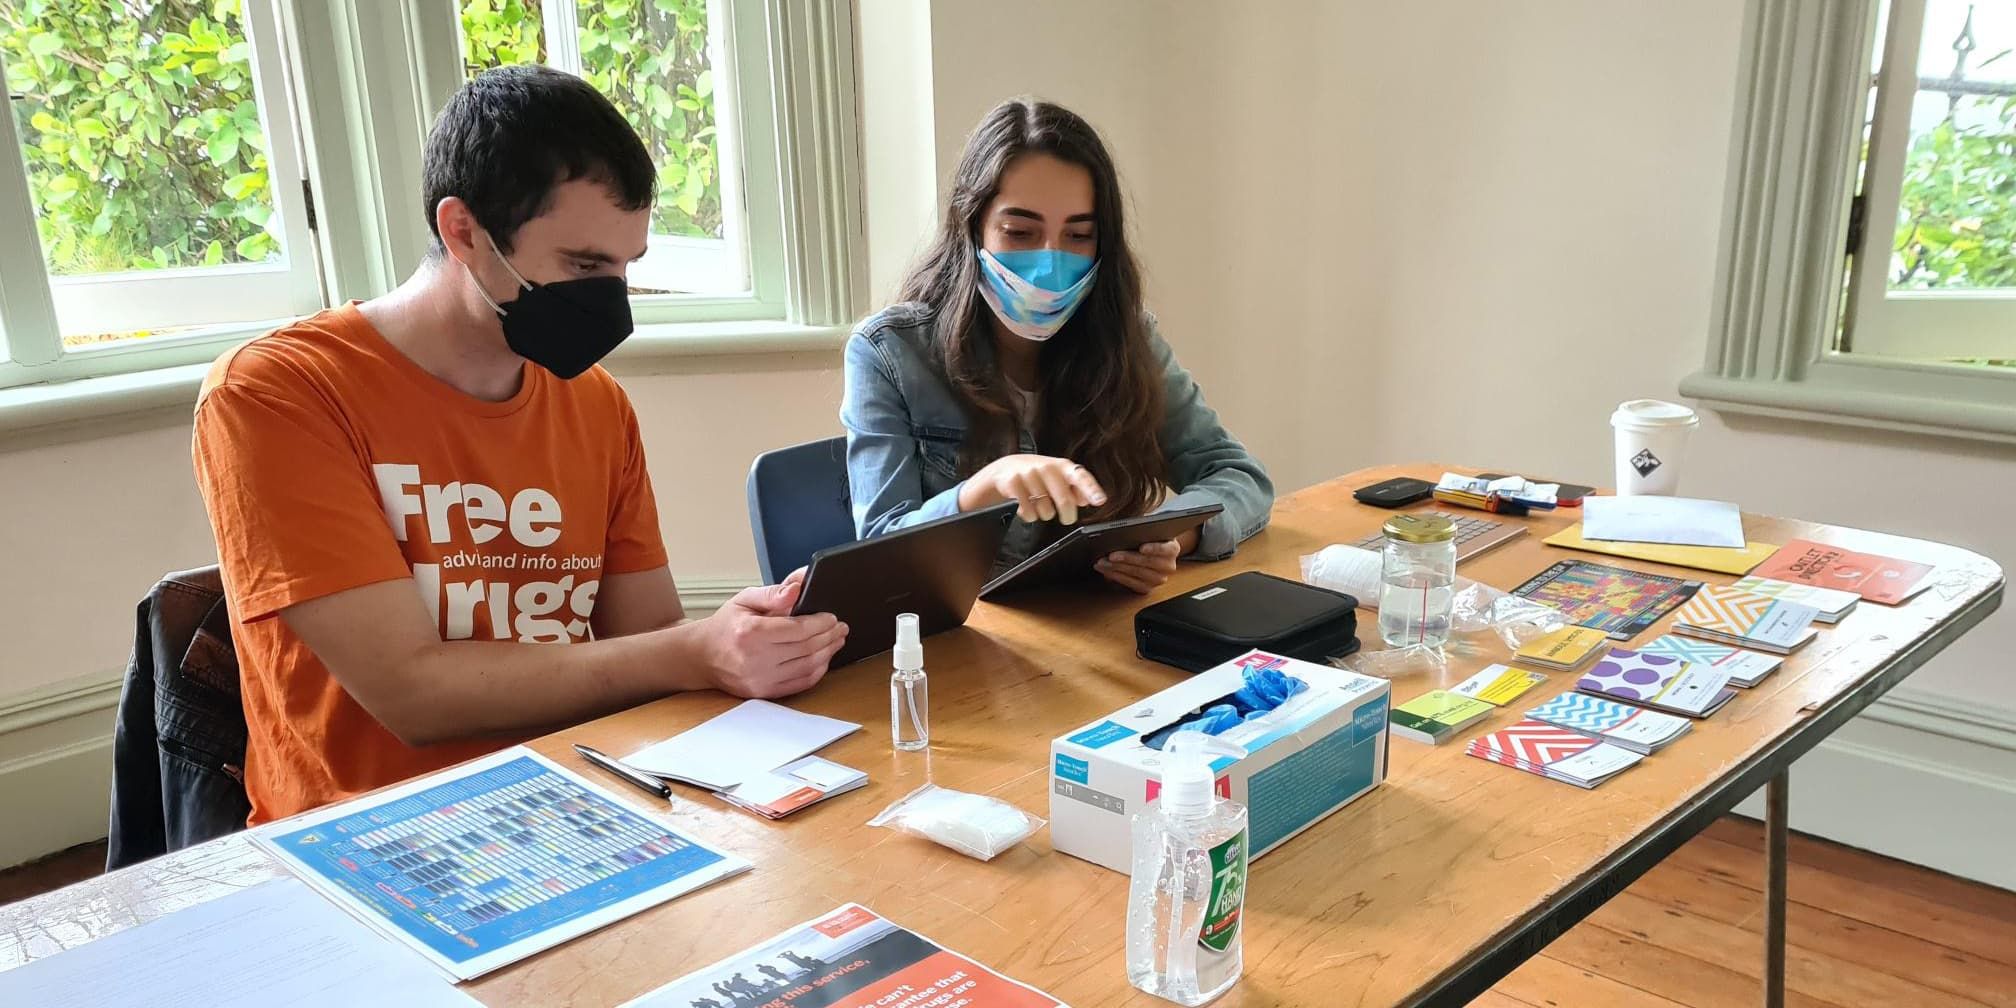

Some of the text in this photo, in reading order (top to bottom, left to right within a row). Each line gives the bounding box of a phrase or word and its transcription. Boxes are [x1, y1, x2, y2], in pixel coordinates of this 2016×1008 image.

[372, 464, 562, 547] Free
[482, 553, 515, 569] and
[521, 553, 557, 570] info
[561, 554, 602, 570] about
[782, 985, 813, 1001] this
[813, 960, 870, 987] service.
[935, 971, 968, 988] that
[952, 980, 977, 995] are
[877, 985, 914, 1006] can't
